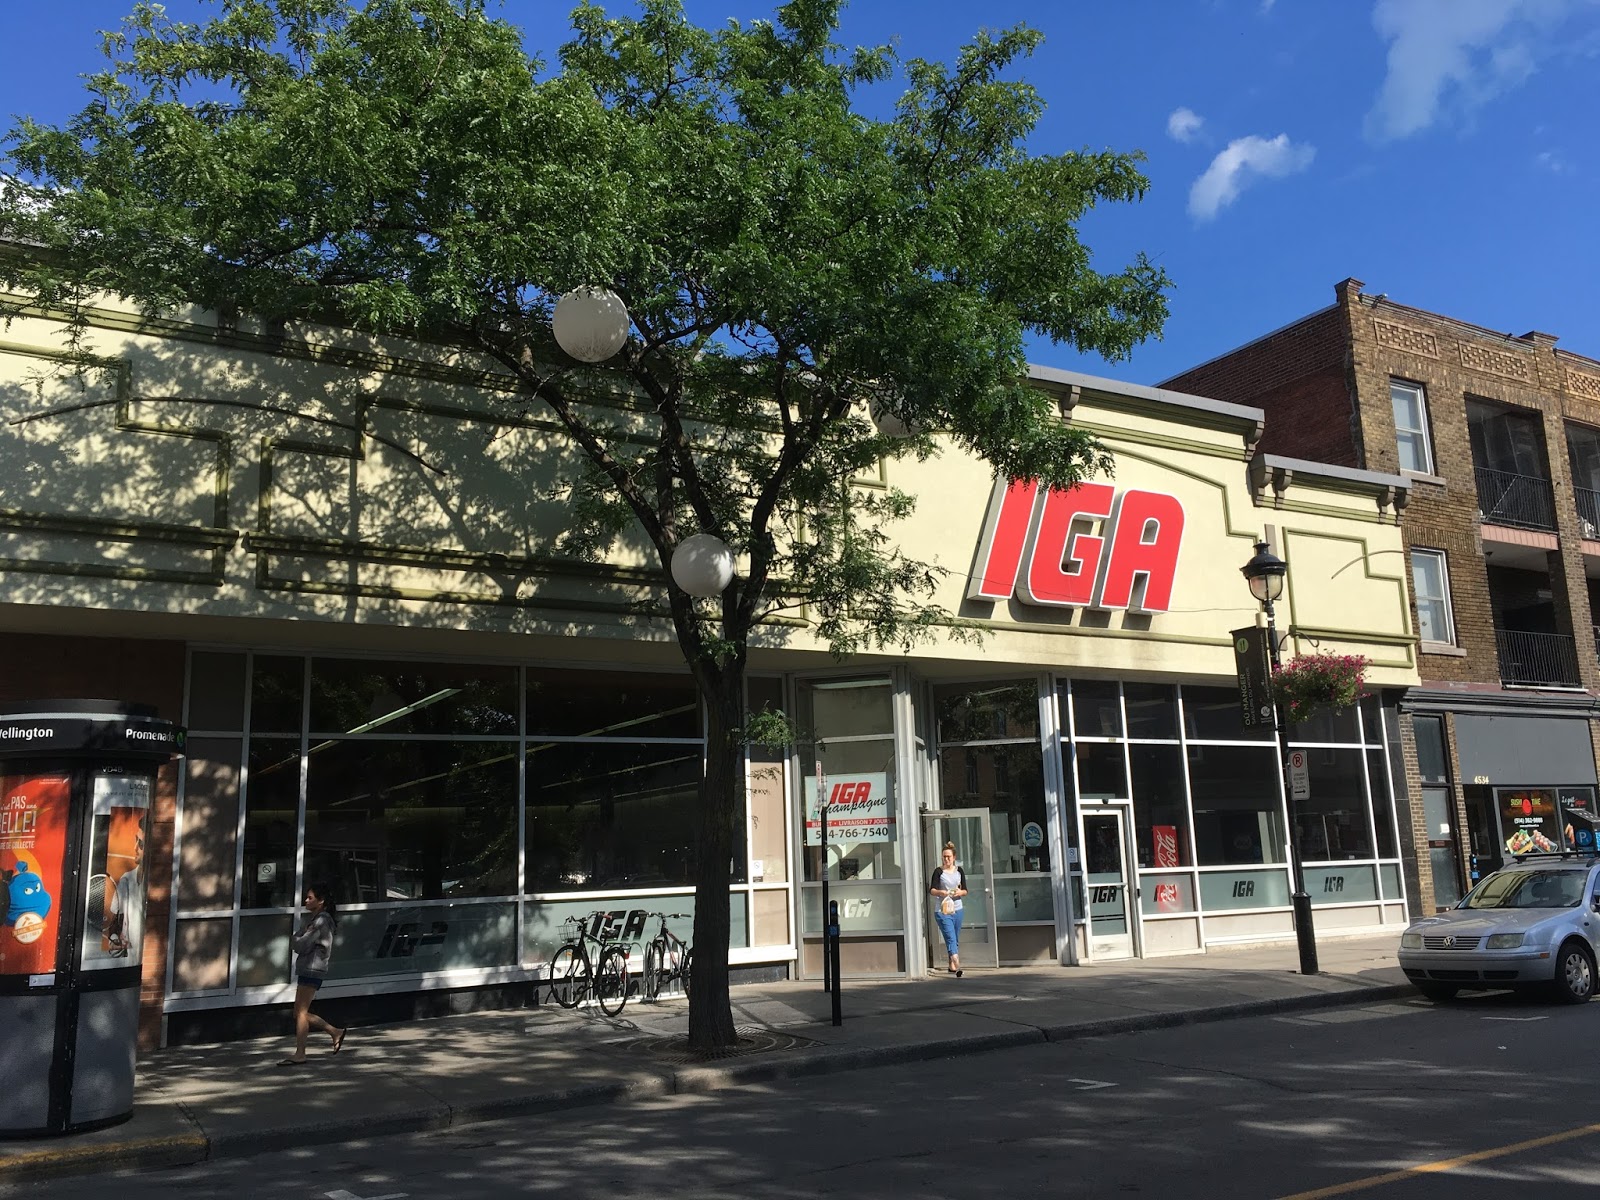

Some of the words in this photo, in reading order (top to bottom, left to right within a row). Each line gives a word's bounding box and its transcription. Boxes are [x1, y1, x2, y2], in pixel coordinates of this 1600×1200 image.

[977, 474, 1185, 613] IGA
[1240, 673, 1250, 711] MANGER
[126, 728, 175, 742] Promenade
[1474, 775, 1489, 785] 4534
[830, 781, 872, 805] IGA
[11, 796, 26, 810] PAS
[819, 797, 887, 815] hampagne
[838, 819, 869, 827] LIVRAISON
[815, 826, 888, 840] 54-766-7540
[12, 840, 35, 850] COLLECTE
[1232, 880, 1255, 898] IGA
[1324, 876, 1344, 893] IGA
[1092, 885, 1117, 904] IGA
[589, 909, 647, 942] IGA
